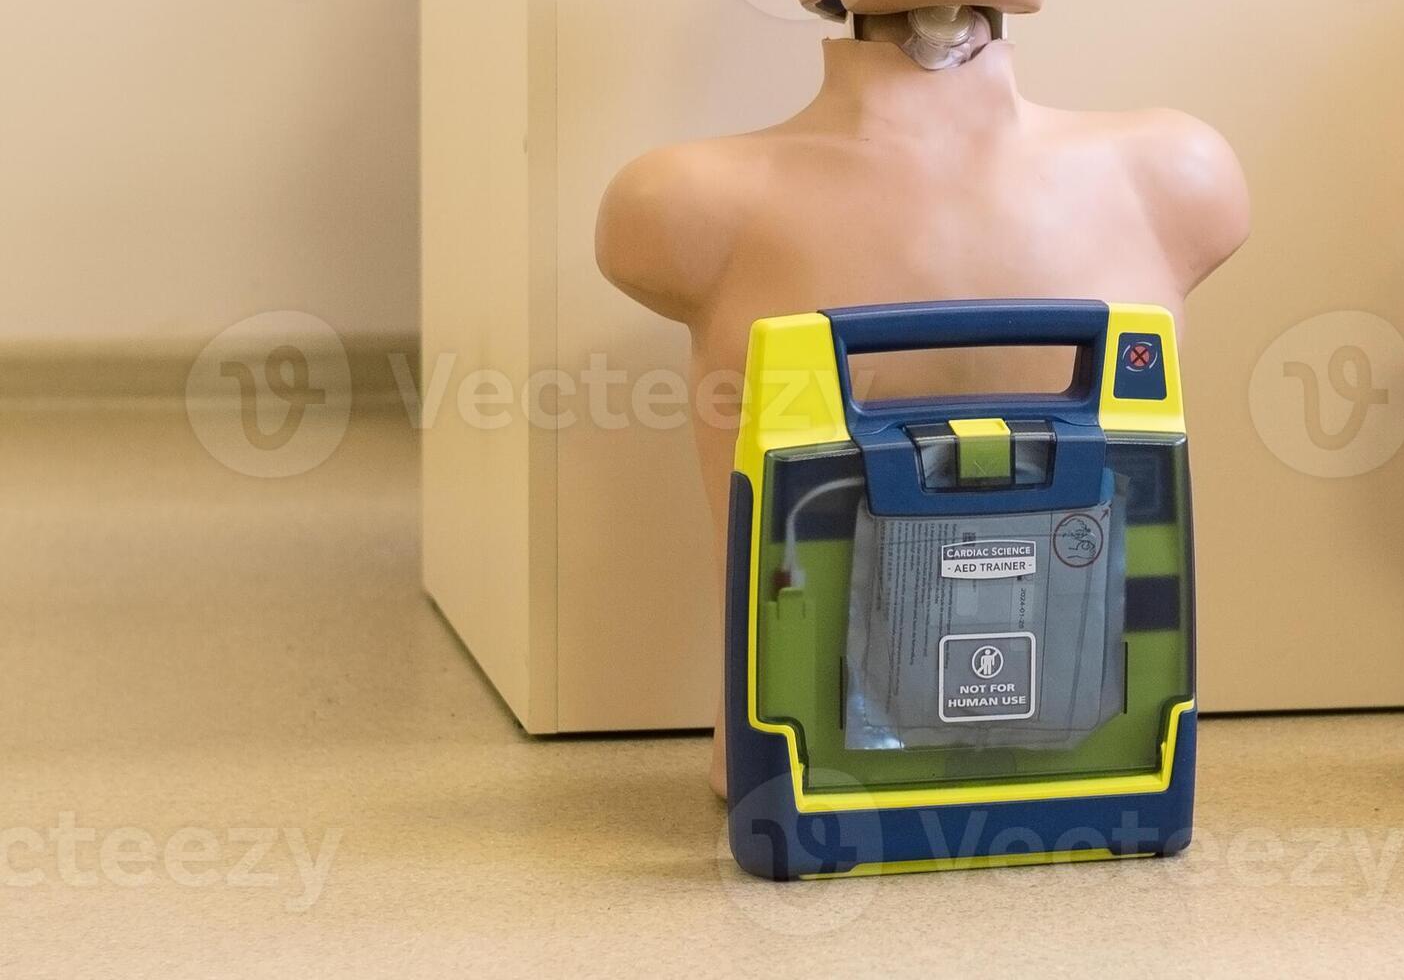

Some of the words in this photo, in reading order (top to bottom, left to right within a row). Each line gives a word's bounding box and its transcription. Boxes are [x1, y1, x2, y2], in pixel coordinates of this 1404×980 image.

[946, 547, 989, 558] CARDIAC
[991, 546, 1031, 556] SCIENCE
[954, 563, 977, 573] AED
[980, 561, 1026, 572] TRAINER
[959, 684, 988, 694] NOT
[990, 683, 1016, 693] FOR
[948, 697, 999, 708] HUMAN
[1002, 695, 1027, 705] USE
